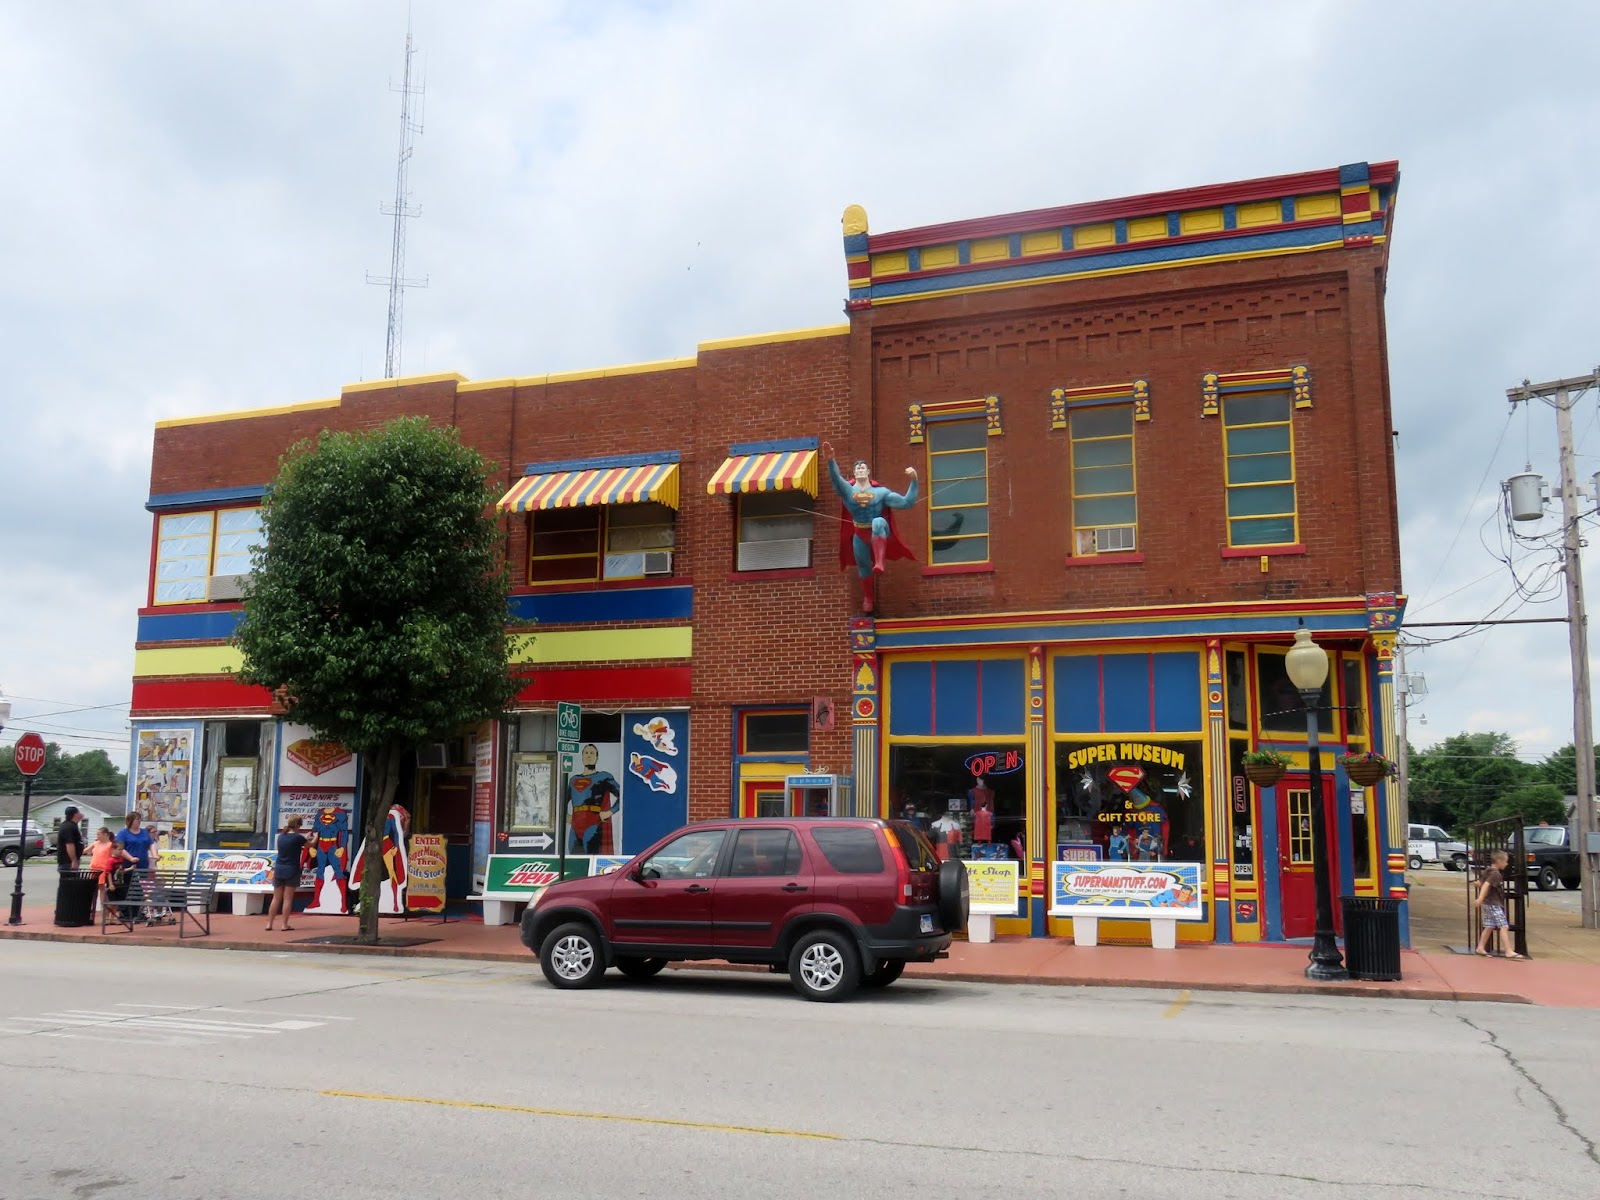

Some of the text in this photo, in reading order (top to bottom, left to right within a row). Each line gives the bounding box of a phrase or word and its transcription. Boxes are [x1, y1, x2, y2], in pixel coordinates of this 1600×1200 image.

[559, 729, 578, 738] BIKE ROUTE
[561, 743, 576, 751] BEGIN
[17, 745, 44, 762] STOP
[1068, 743, 1185, 770] SUPER MUSEUM
[971, 750, 1018, 777] OPEN
[1235, 778, 1244, 810] OPEN
[1124, 800, 1133, 809] &
[1097, 813, 1161, 822] GIFT STORE
[415, 836, 440, 845] ENTER
[1062, 849, 1097, 861] SUPER
[207, 860, 265, 870] SUPERMANSTUFF.COM
[417, 858, 437, 866] Thru
[408, 864, 445, 878] Gift Store
[982, 867, 1012, 877] Shop
[1235, 865, 1252, 873] OPEN
[1073, 876, 1167, 889] SUPERMANSTUFF.COM
